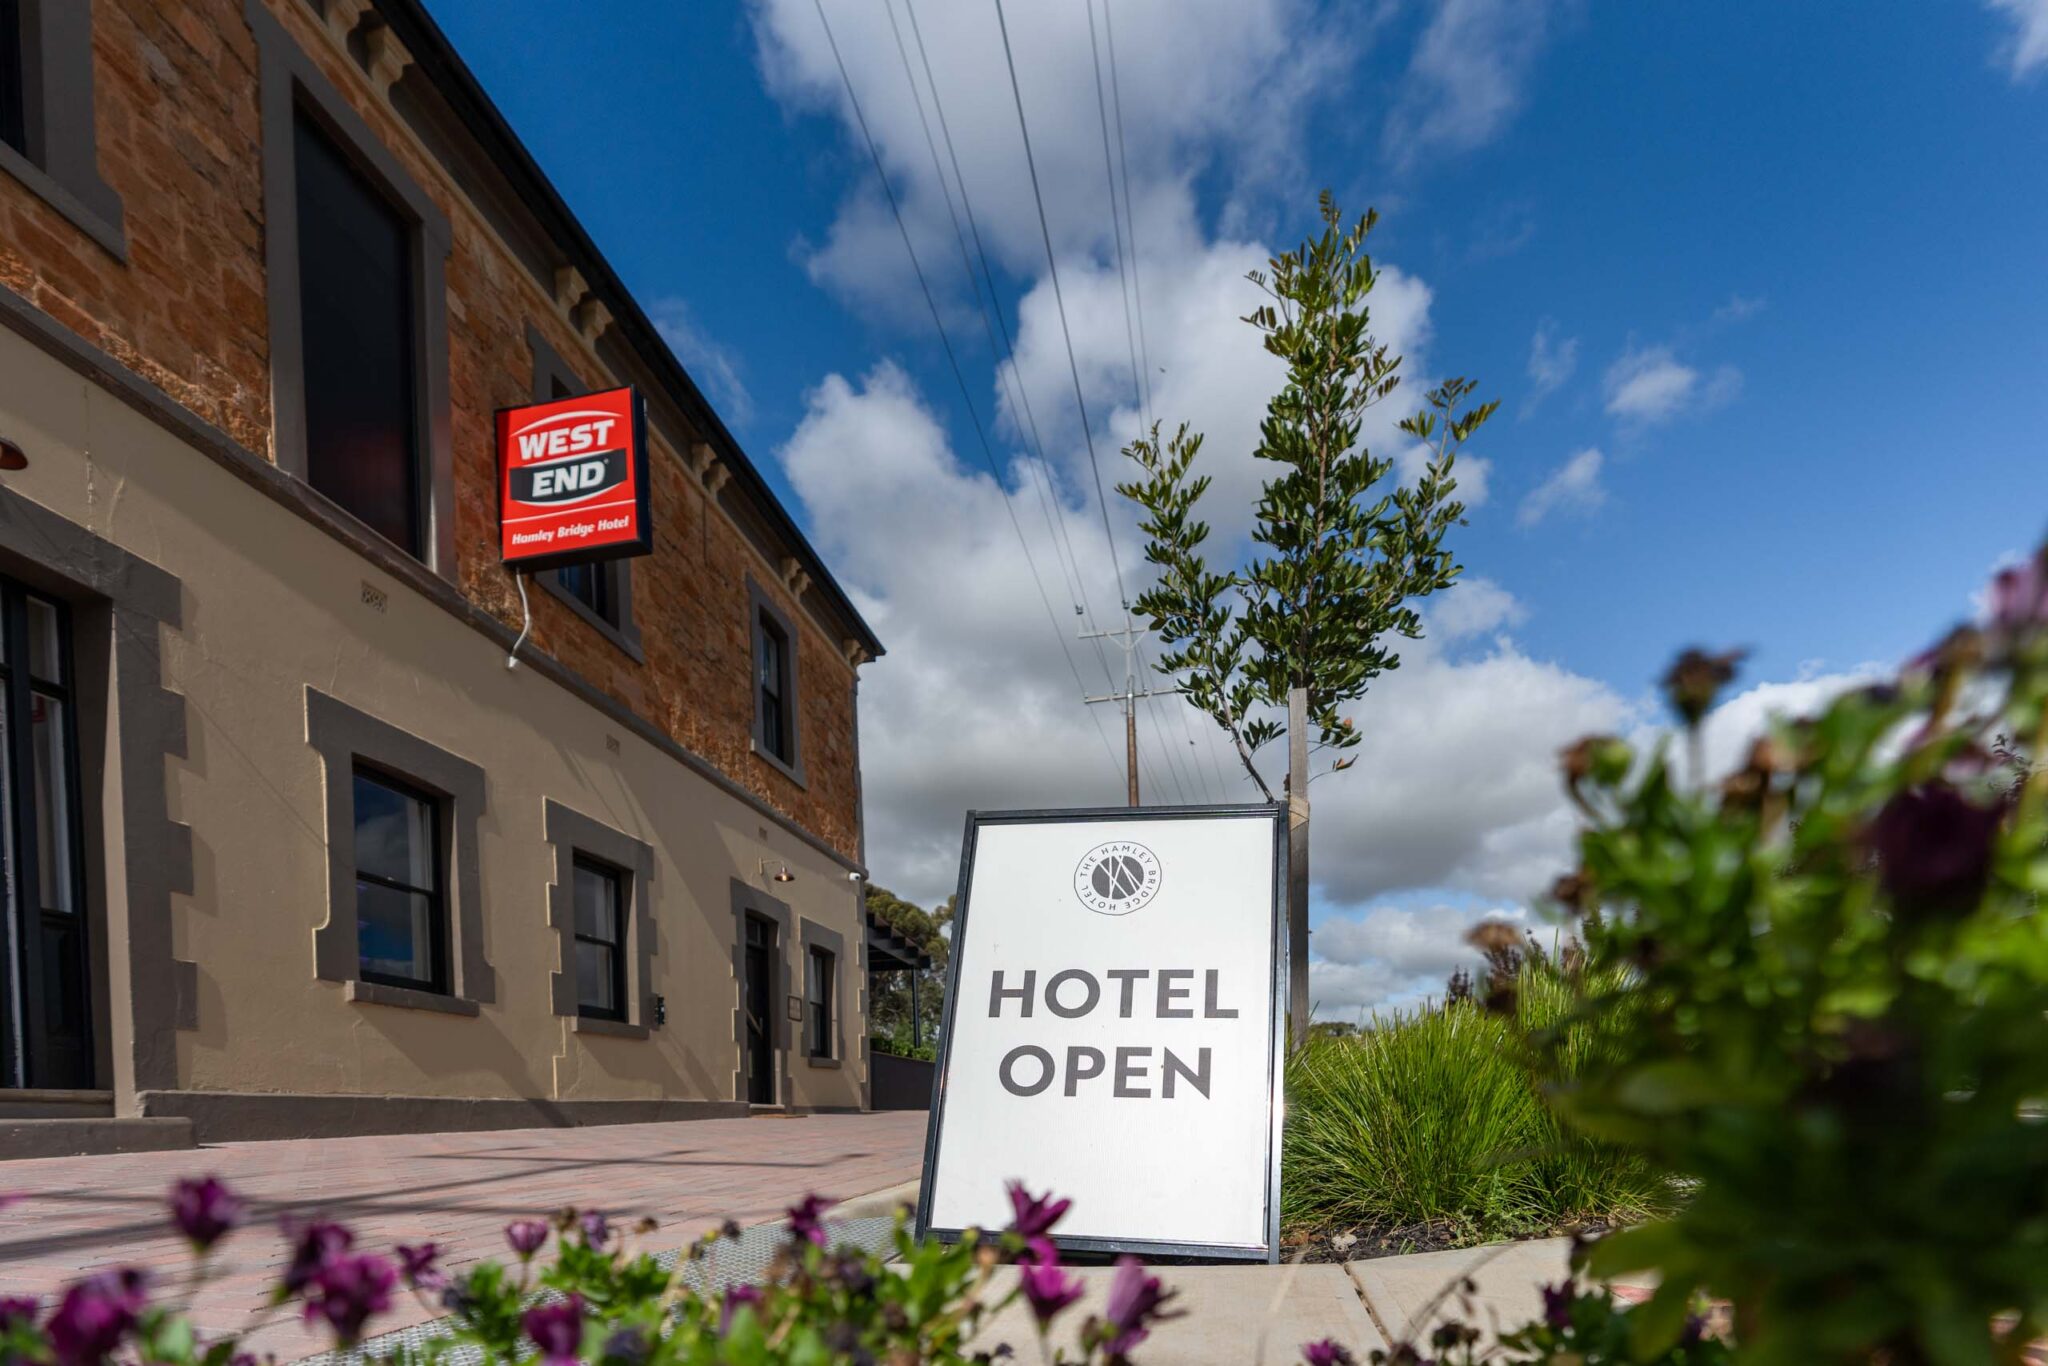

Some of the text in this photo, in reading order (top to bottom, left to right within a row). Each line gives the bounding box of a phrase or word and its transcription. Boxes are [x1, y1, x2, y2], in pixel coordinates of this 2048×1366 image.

[519, 419, 615, 460] WEST
[532, 460, 605, 497] END
[512, 515, 630, 545] Hamley Bridge Hotel
[1080, 845, 1157, 911] THE HAMLEY BRIDGE HOTEL
[988, 969, 1239, 1018] HOTEL
[999, 1044, 1212, 1100] OPEN
